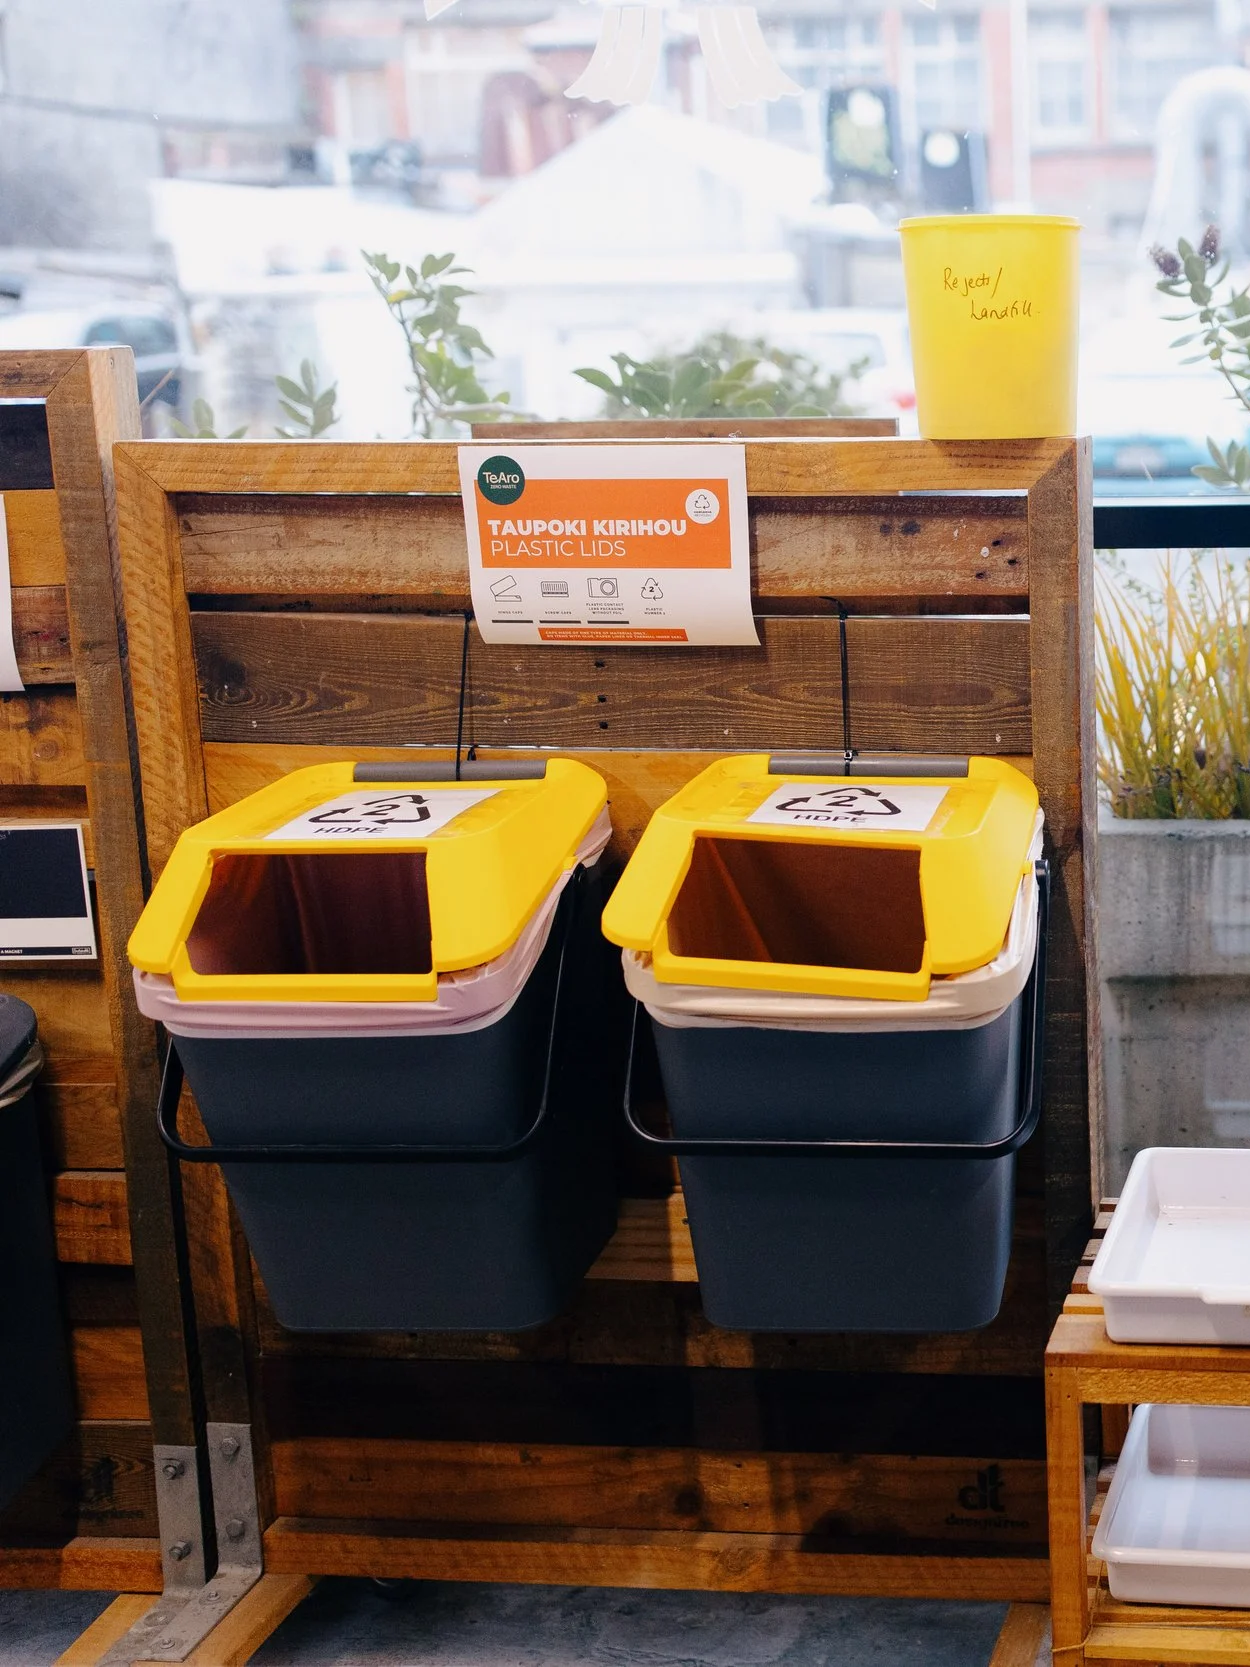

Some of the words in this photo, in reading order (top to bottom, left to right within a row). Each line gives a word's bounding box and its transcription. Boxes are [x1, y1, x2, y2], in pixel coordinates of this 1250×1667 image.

[482, 472, 520, 484] TeAro
[487, 519, 587, 536] TAUPOKI
[593, 519, 687, 536] KIRIHOU
[491, 540, 574, 556] PLASTIC
[580, 540, 626, 556] LIDS
[825, 795, 859, 807] 2
[360, 804, 401, 815] 2
[793, 814, 868, 823] HDPE
